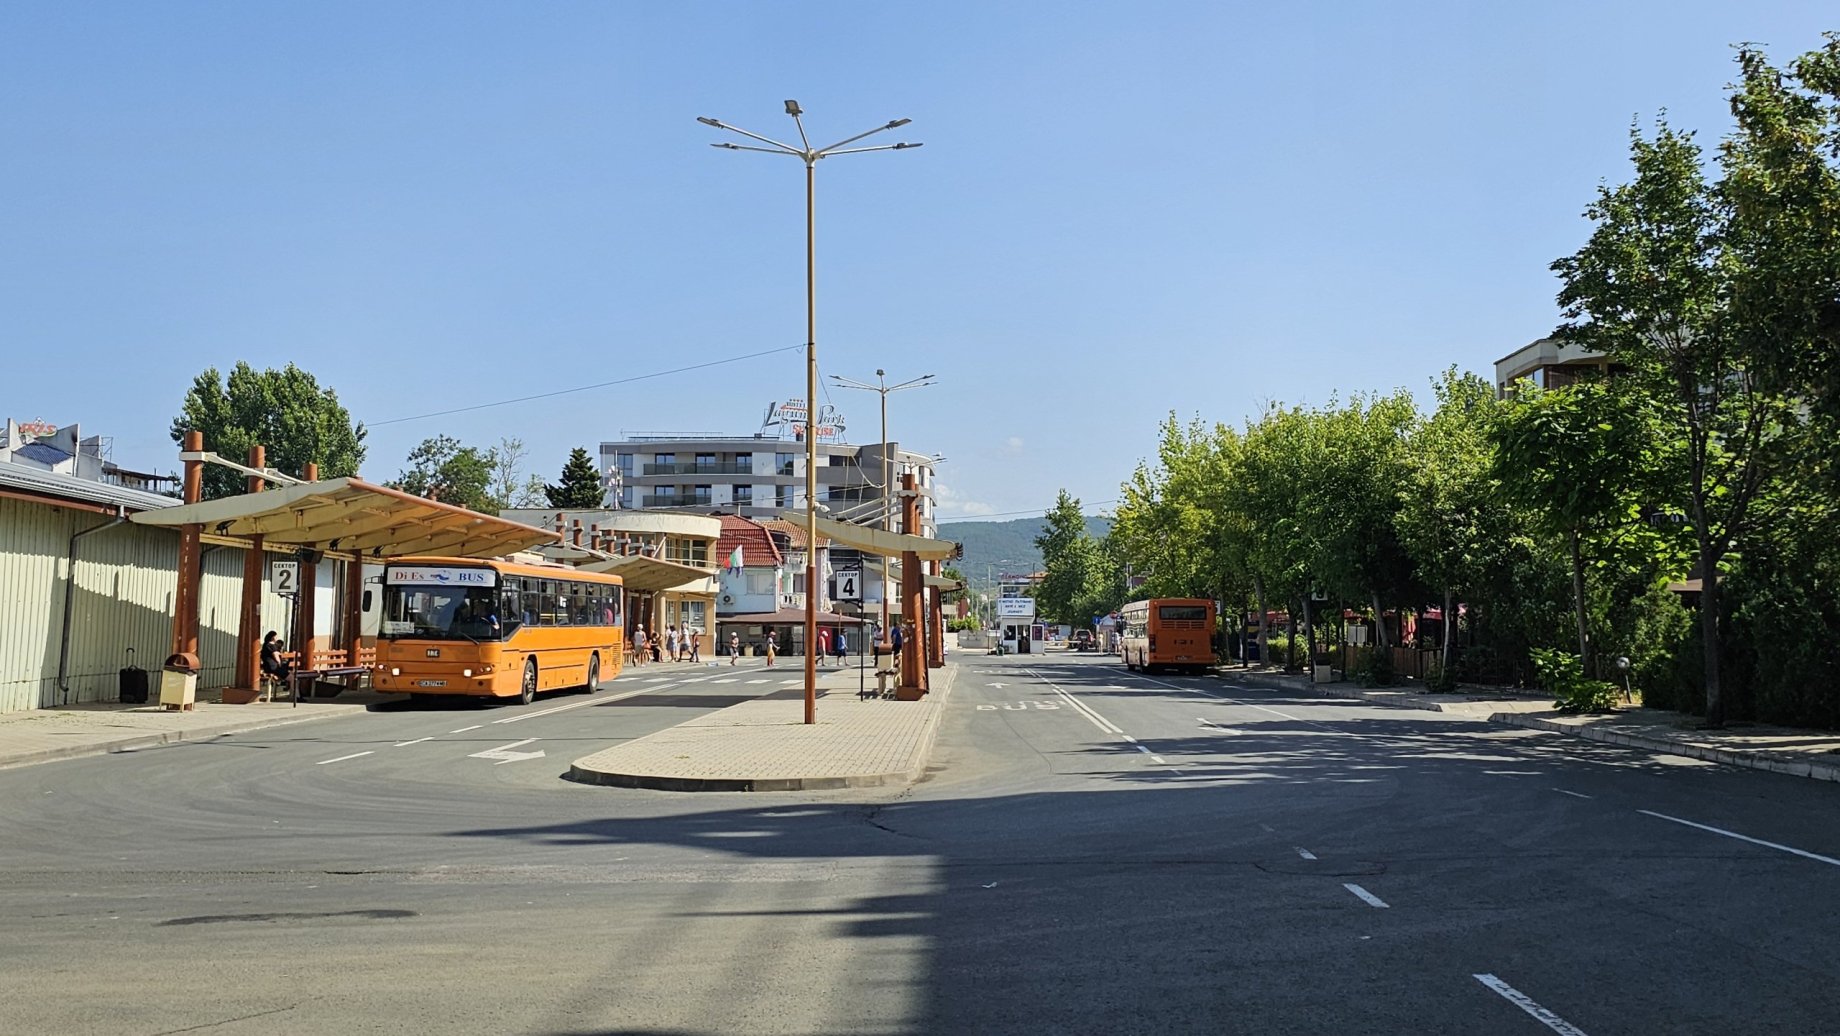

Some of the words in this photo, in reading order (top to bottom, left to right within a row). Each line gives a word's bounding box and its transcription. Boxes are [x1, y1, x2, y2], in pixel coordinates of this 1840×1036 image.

[279, 569, 291, 589] 2
[459, 573, 484, 581] BUS
[843, 578, 854, 596] 4
